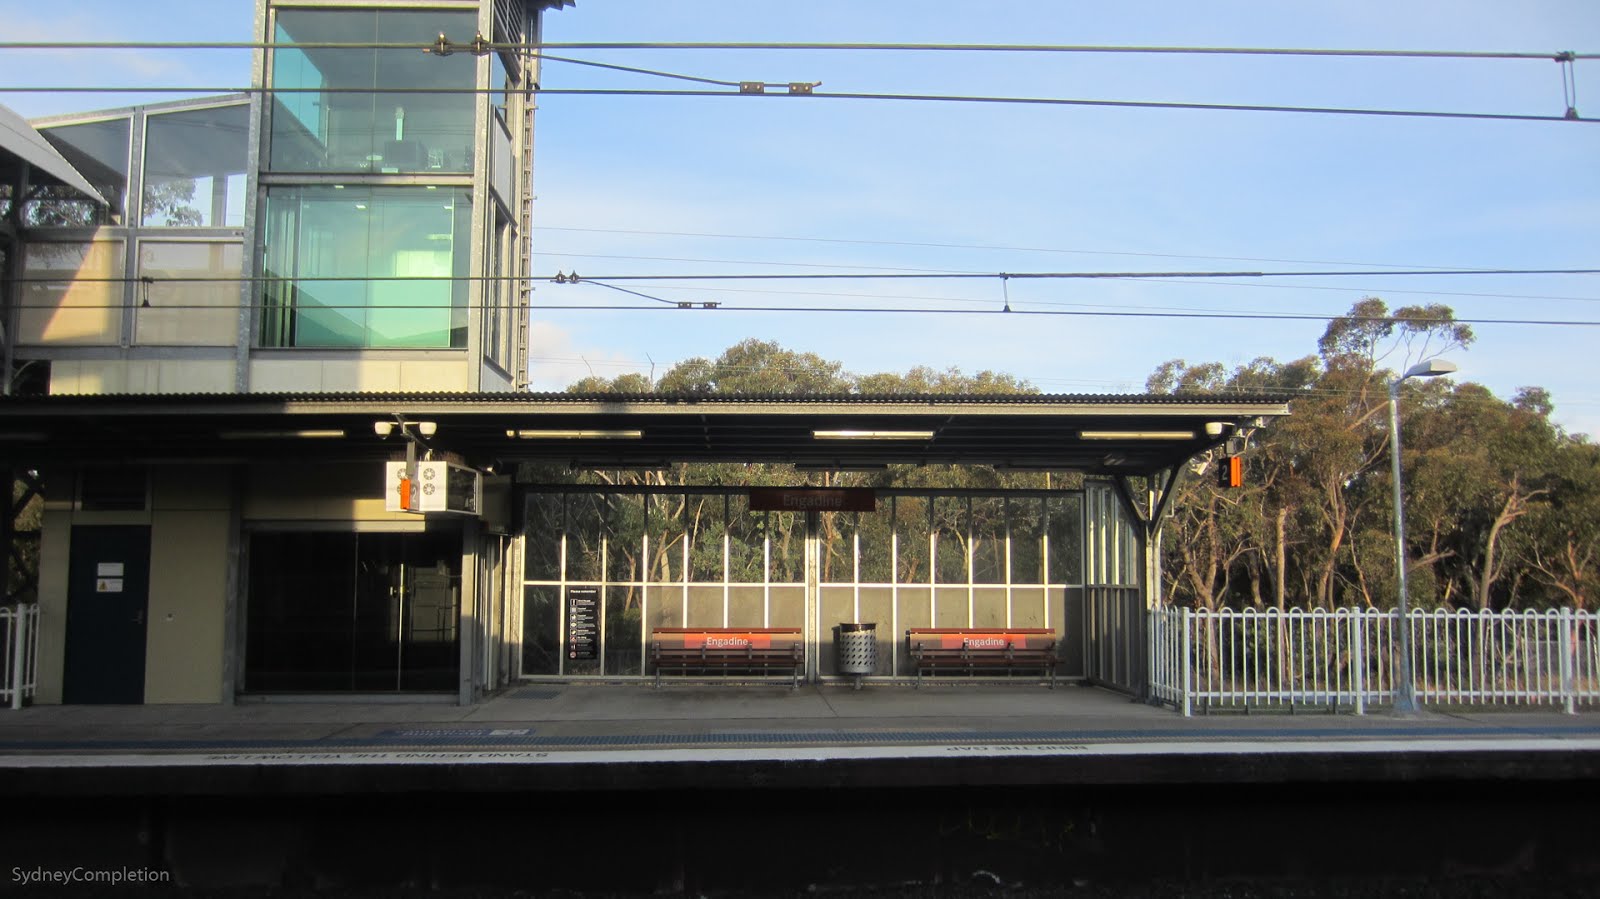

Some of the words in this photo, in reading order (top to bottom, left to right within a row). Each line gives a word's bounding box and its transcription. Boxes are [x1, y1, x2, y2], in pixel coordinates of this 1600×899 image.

[1222, 464, 1228, 481] 2
[783, 494, 843, 508] Engadine
[706, 636, 748, 647] Engadine
[963, 637, 1005, 647] Engadine
